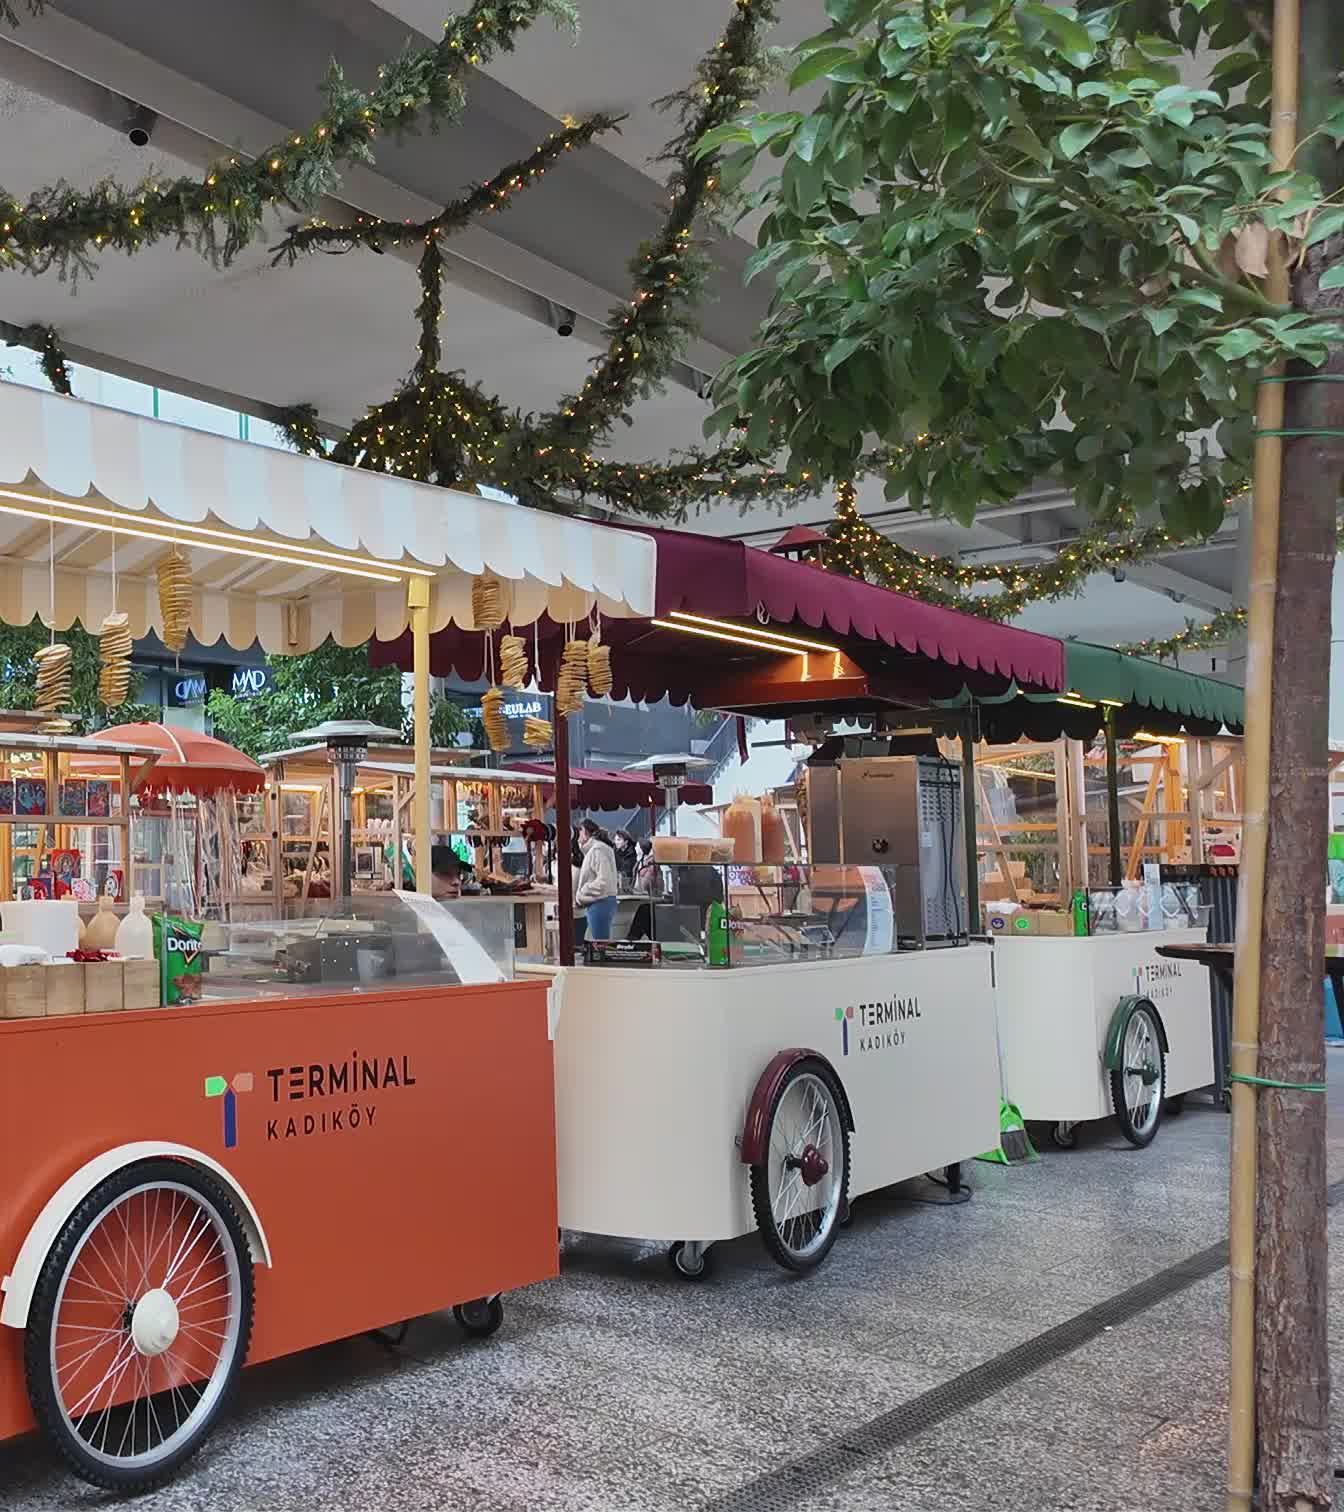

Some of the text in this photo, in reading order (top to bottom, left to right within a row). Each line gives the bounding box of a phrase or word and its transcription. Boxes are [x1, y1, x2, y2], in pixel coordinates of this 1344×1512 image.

[232, 669, 266, 693] MAD
[859, 993, 921, 1027] TERMİNAL
[859, 1028, 906, 1052] KADIKÖY
[267, 1050, 416, 1102] TERMİNAL
[267, 1104, 376, 1140] KADIKÖY
